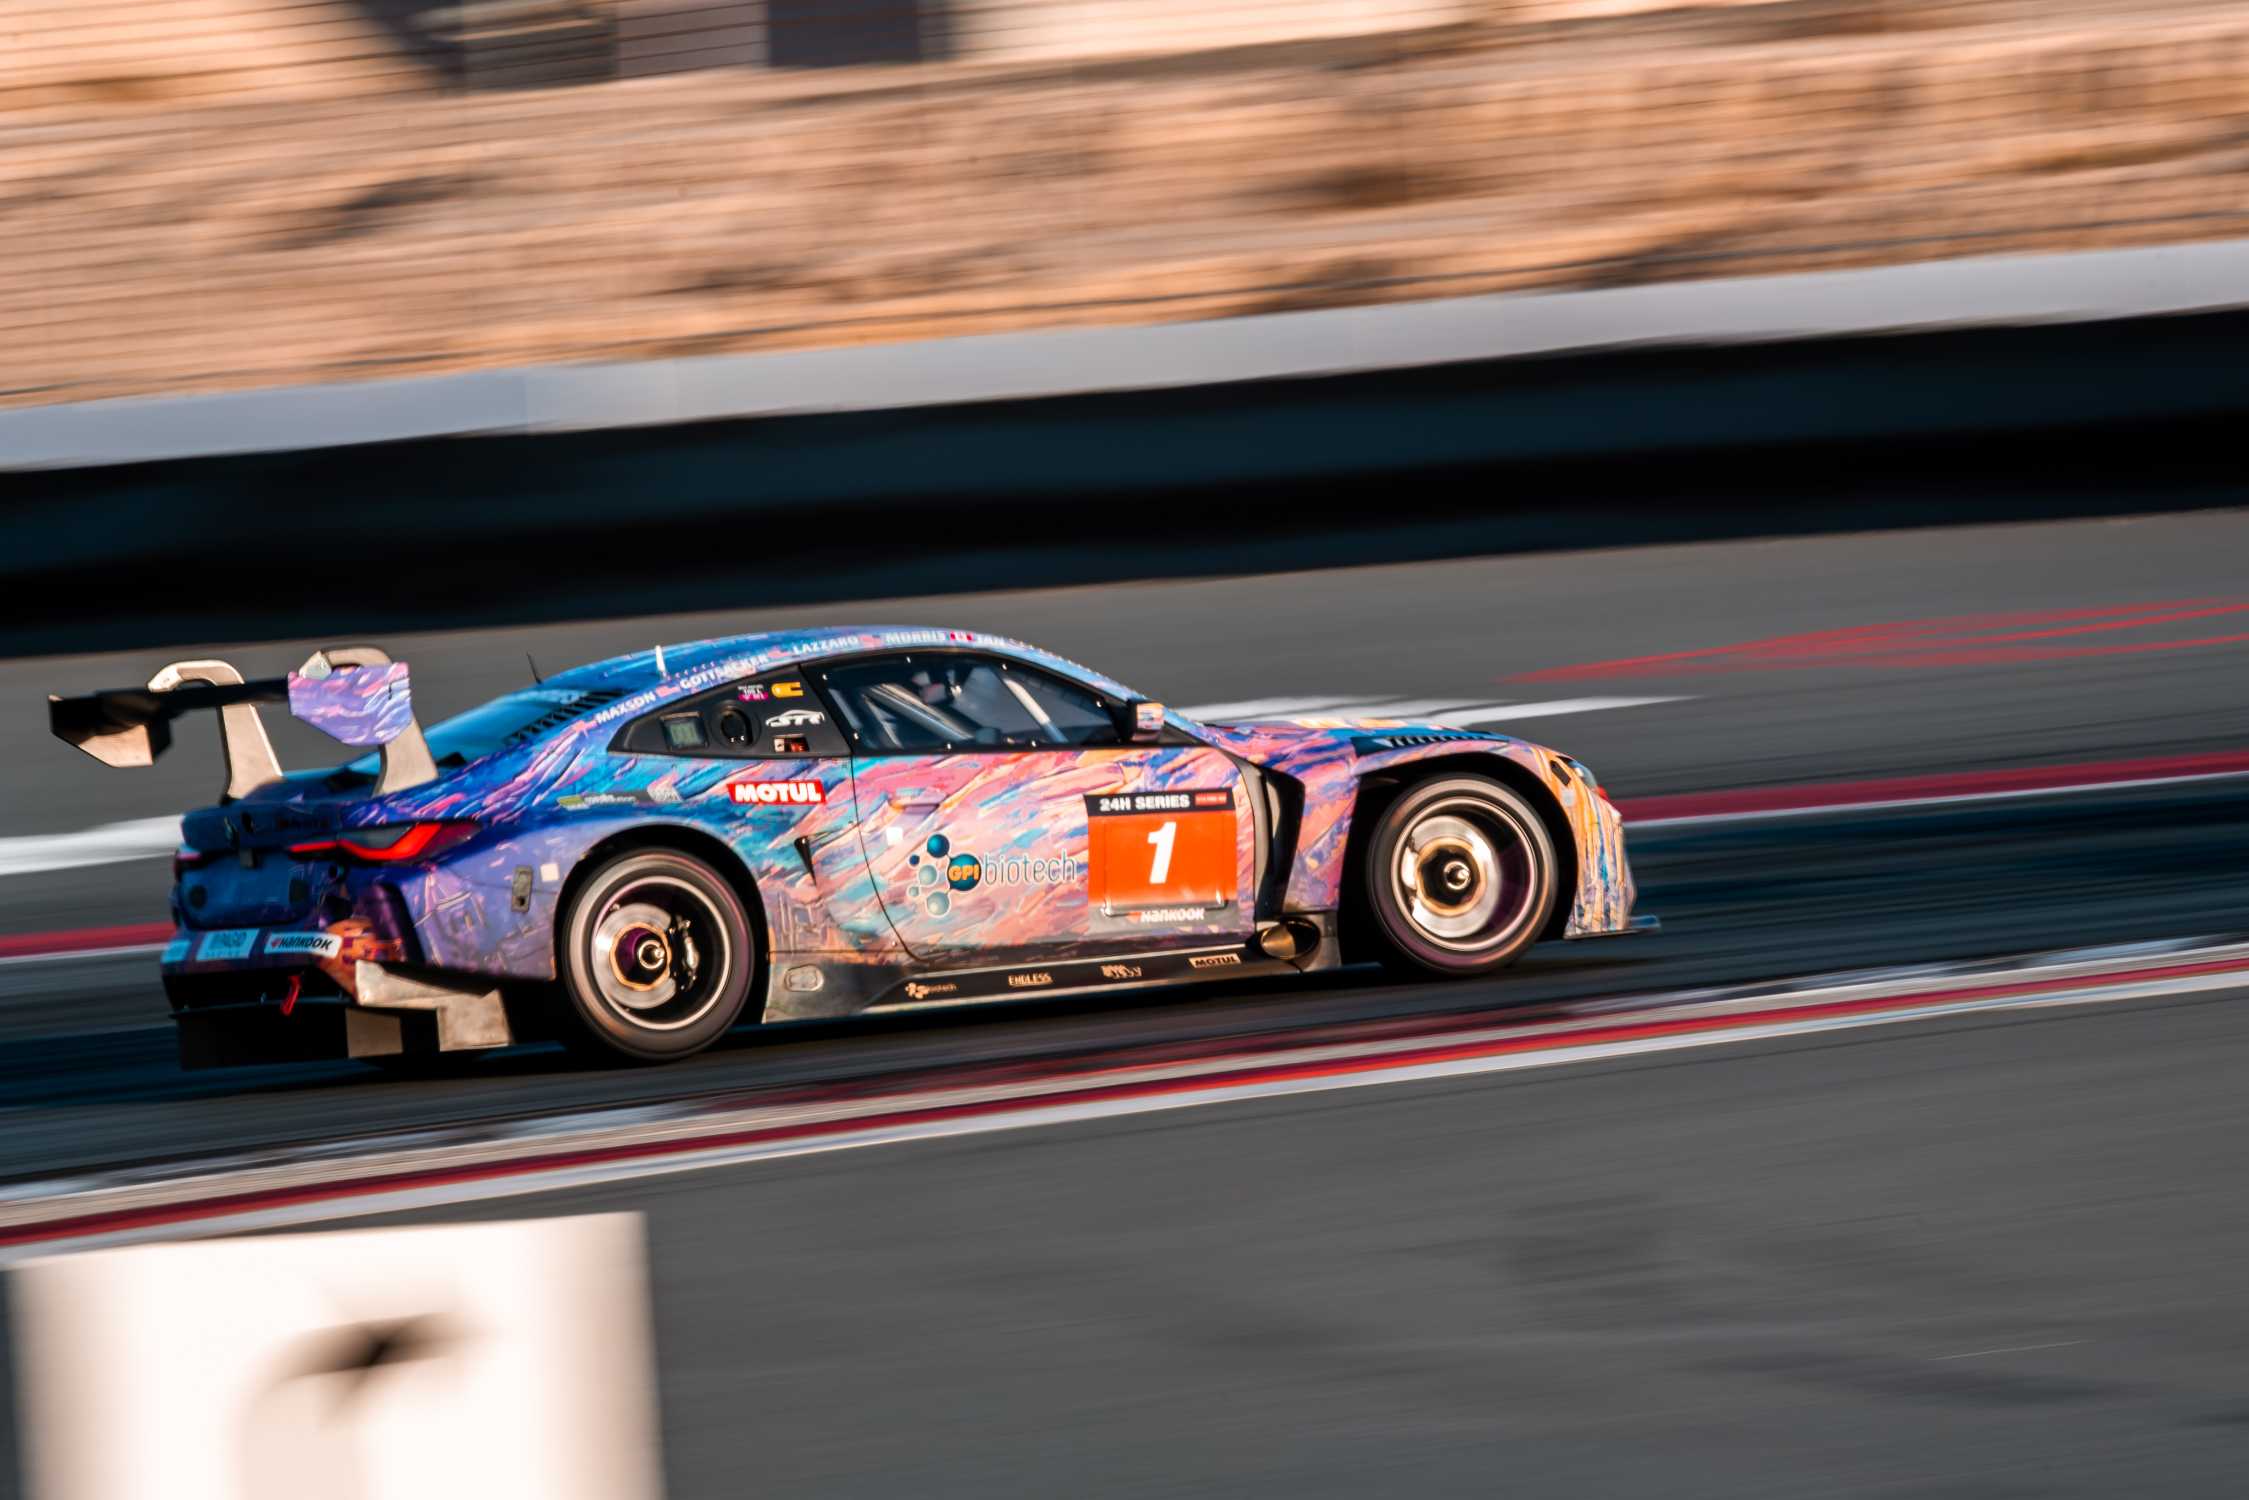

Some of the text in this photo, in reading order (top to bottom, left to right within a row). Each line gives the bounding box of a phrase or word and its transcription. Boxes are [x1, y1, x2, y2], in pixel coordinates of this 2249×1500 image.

[595, 691, 657, 724] MAXSON
[792, 635, 859, 654] LAZZARO
[885, 631, 947, 645] MORRIS
[734, 782, 822, 803] MOTUL
[1100, 797, 1131, 812] 24H
[1135, 794, 1191, 810] SERIES
[1147, 821, 1177, 884] 1
[948, 848, 1077, 886] GPI biotech
[1194, 956, 1237, 968] MOTUL
[1008, 972, 1053, 987] ENDLESS
